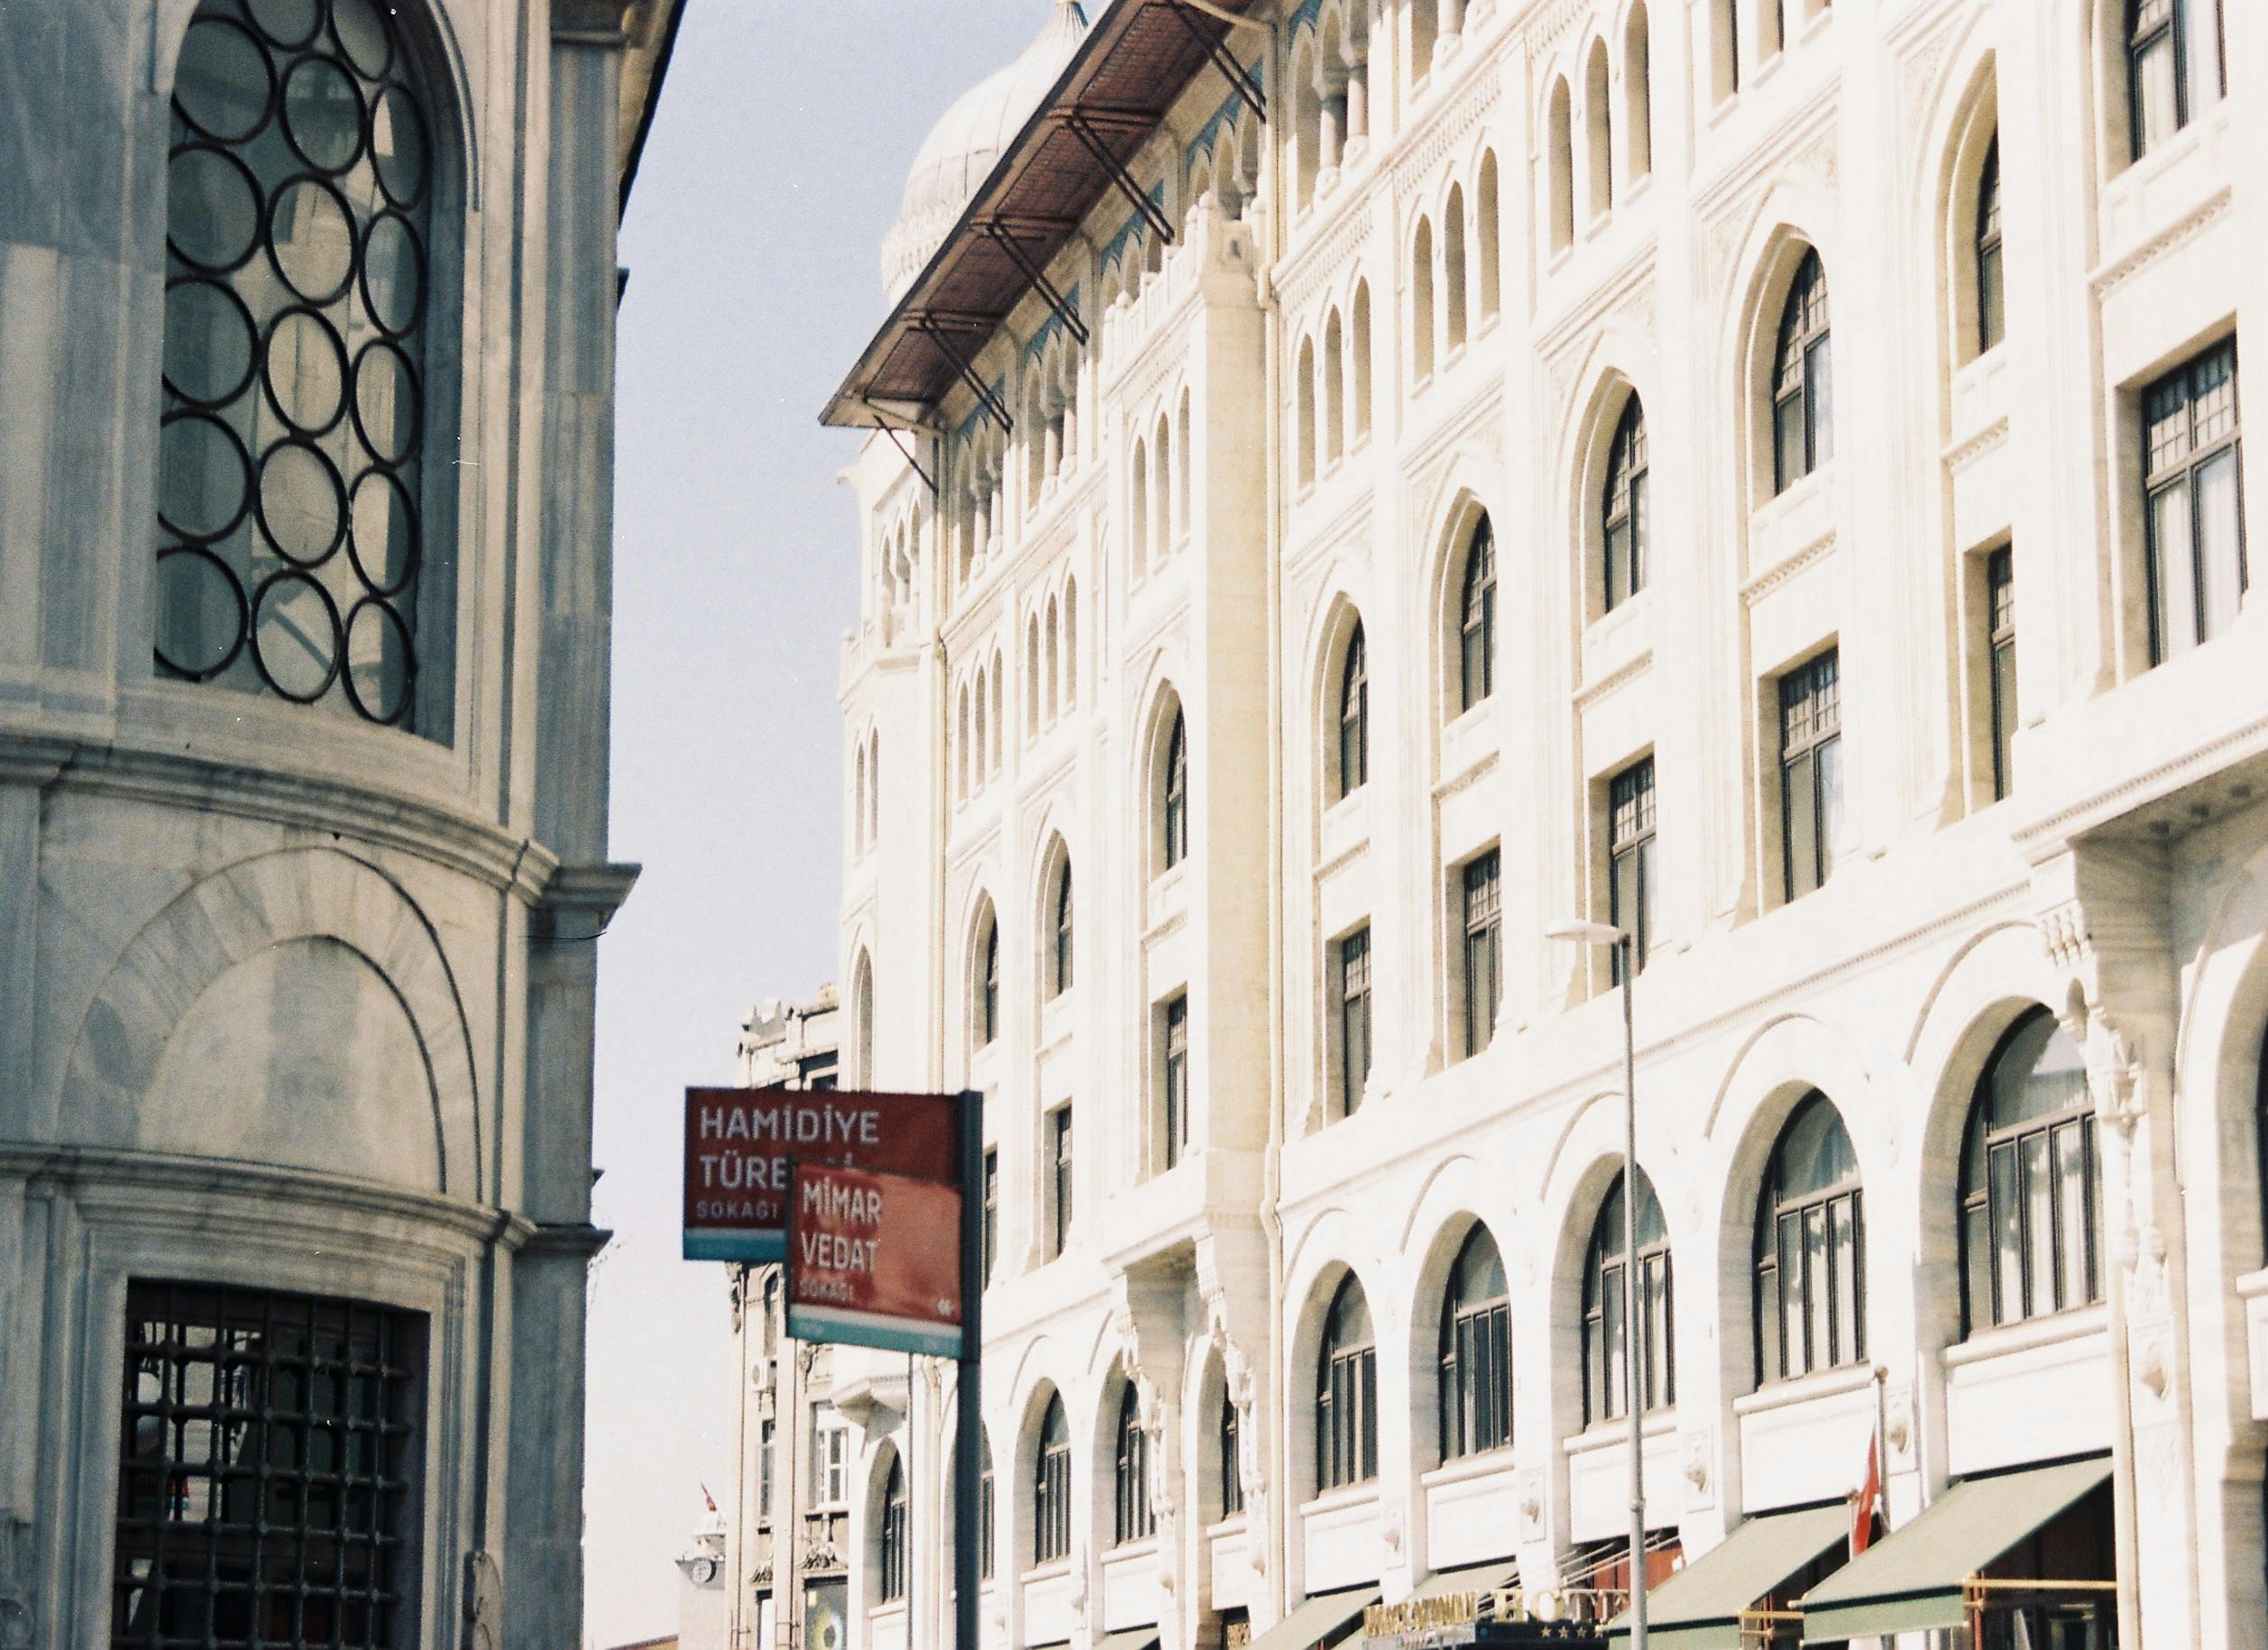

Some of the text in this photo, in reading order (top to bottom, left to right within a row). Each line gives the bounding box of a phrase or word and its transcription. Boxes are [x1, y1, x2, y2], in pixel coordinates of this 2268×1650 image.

[699, 1105, 880, 1144] HAMİDİYE
[803, 1176, 882, 1224] MİMAR
[801, 1231, 879, 1273] VEDAT
